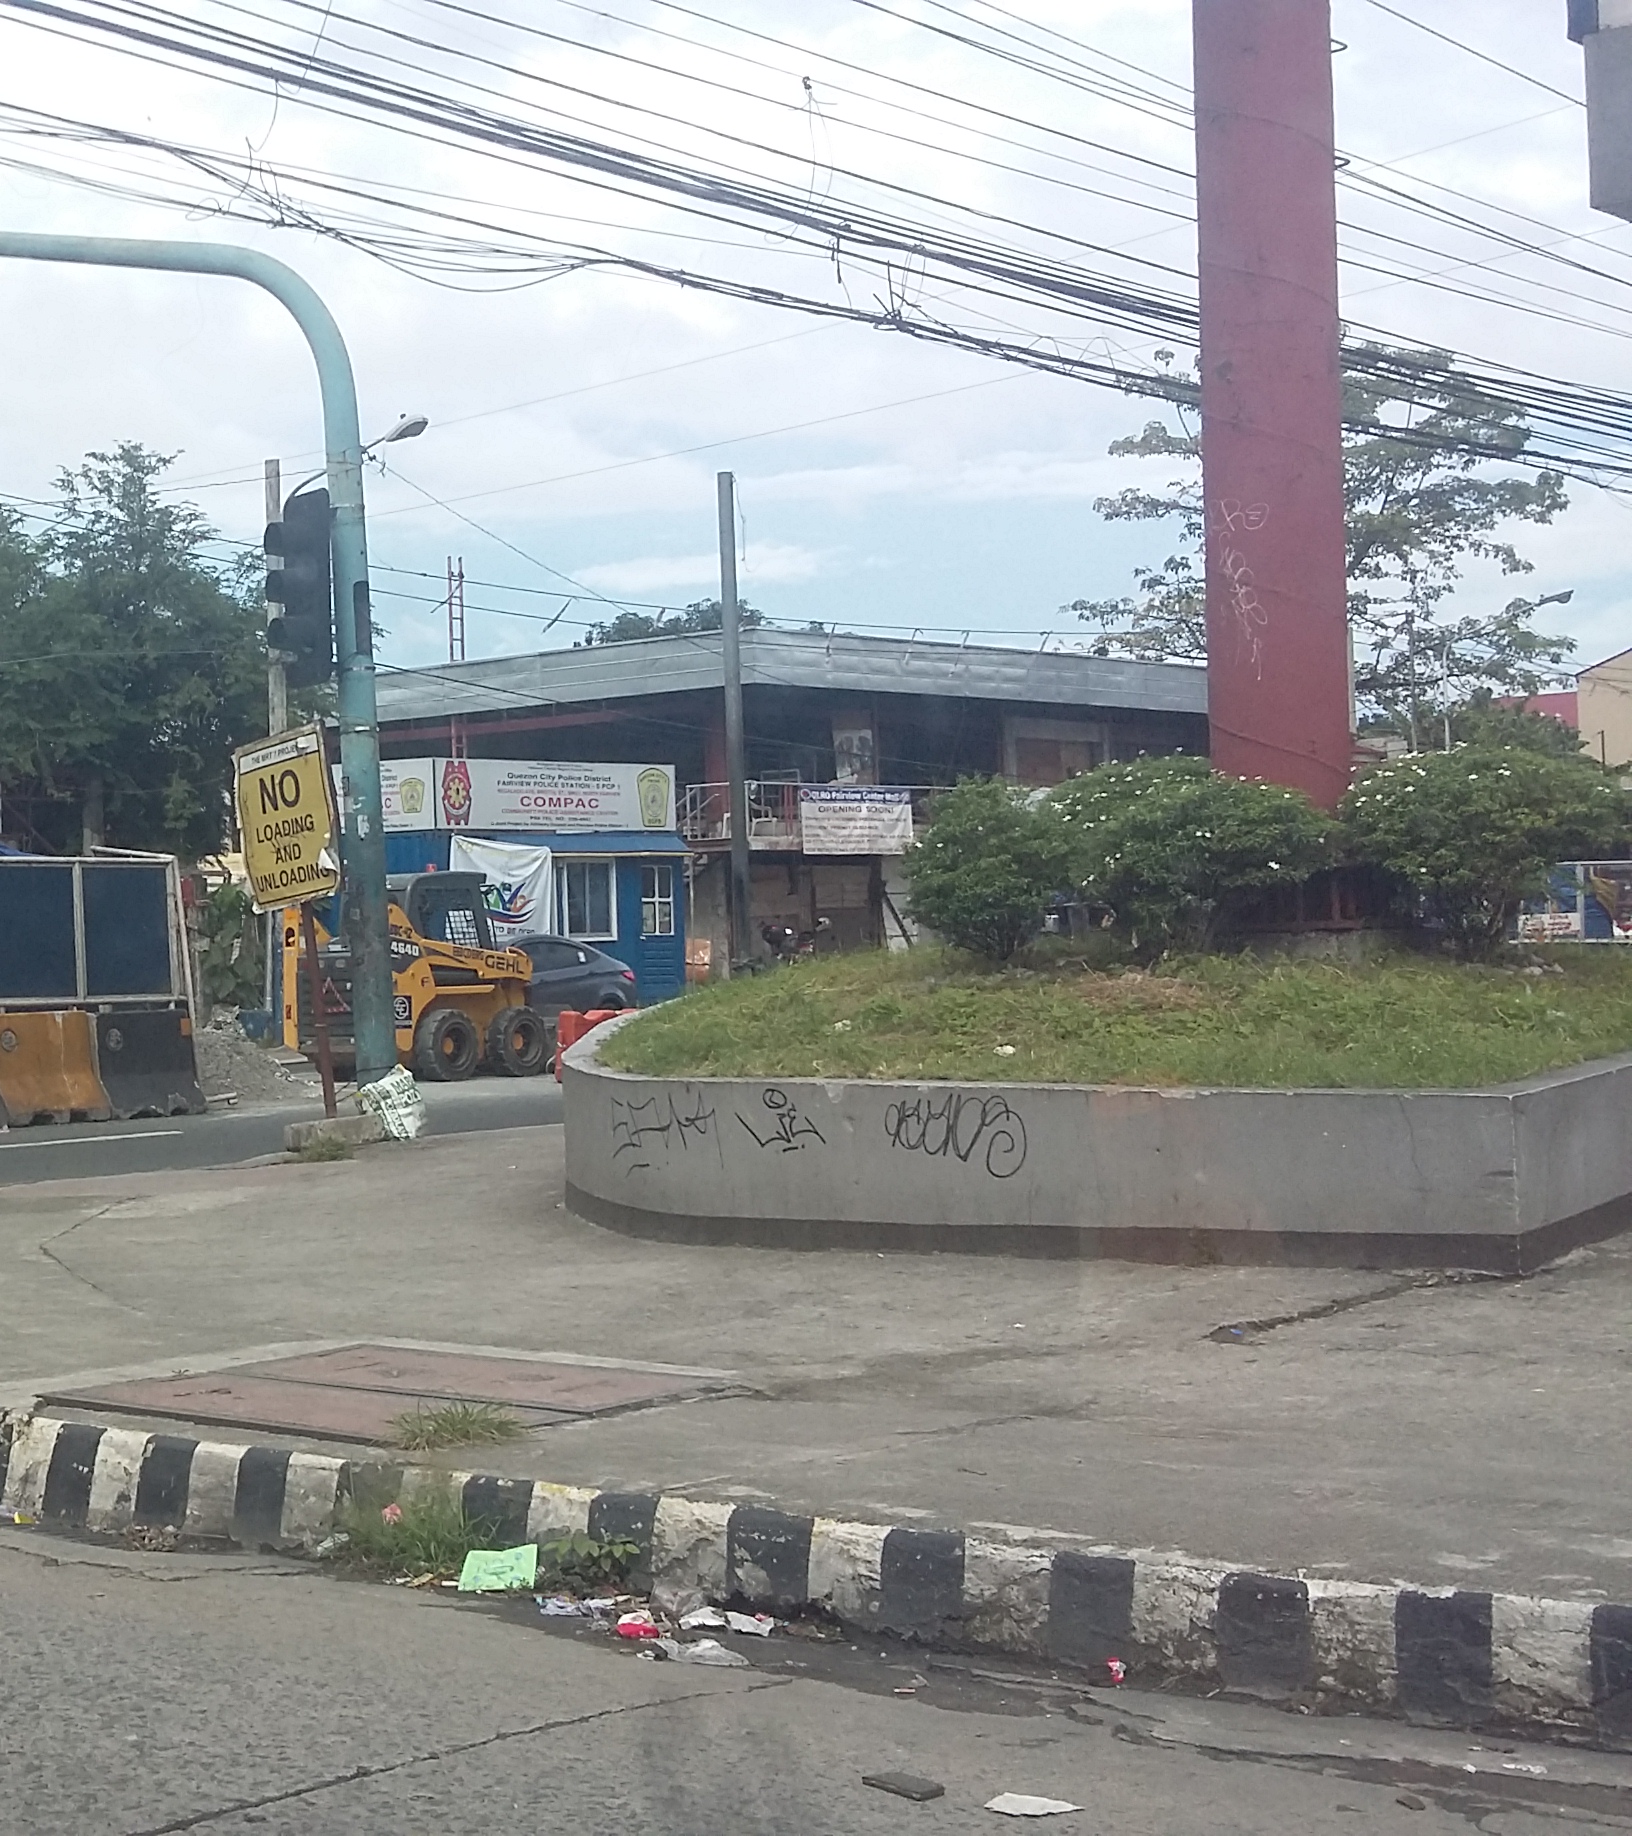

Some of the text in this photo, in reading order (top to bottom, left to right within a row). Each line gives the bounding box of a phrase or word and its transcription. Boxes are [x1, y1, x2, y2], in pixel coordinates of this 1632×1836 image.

[507, 772, 611, 783] Quezon City Police District
[258, 769, 301, 815] NO
[520, 796, 600, 809] COMPAC
[256, 814, 315, 843] LOADING
[275, 843, 302, 865] AND
[256, 862, 330, 893] UNLOADING
[390, 941, 420, 957] 4640
[485, 954, 525, 974] GEHL
